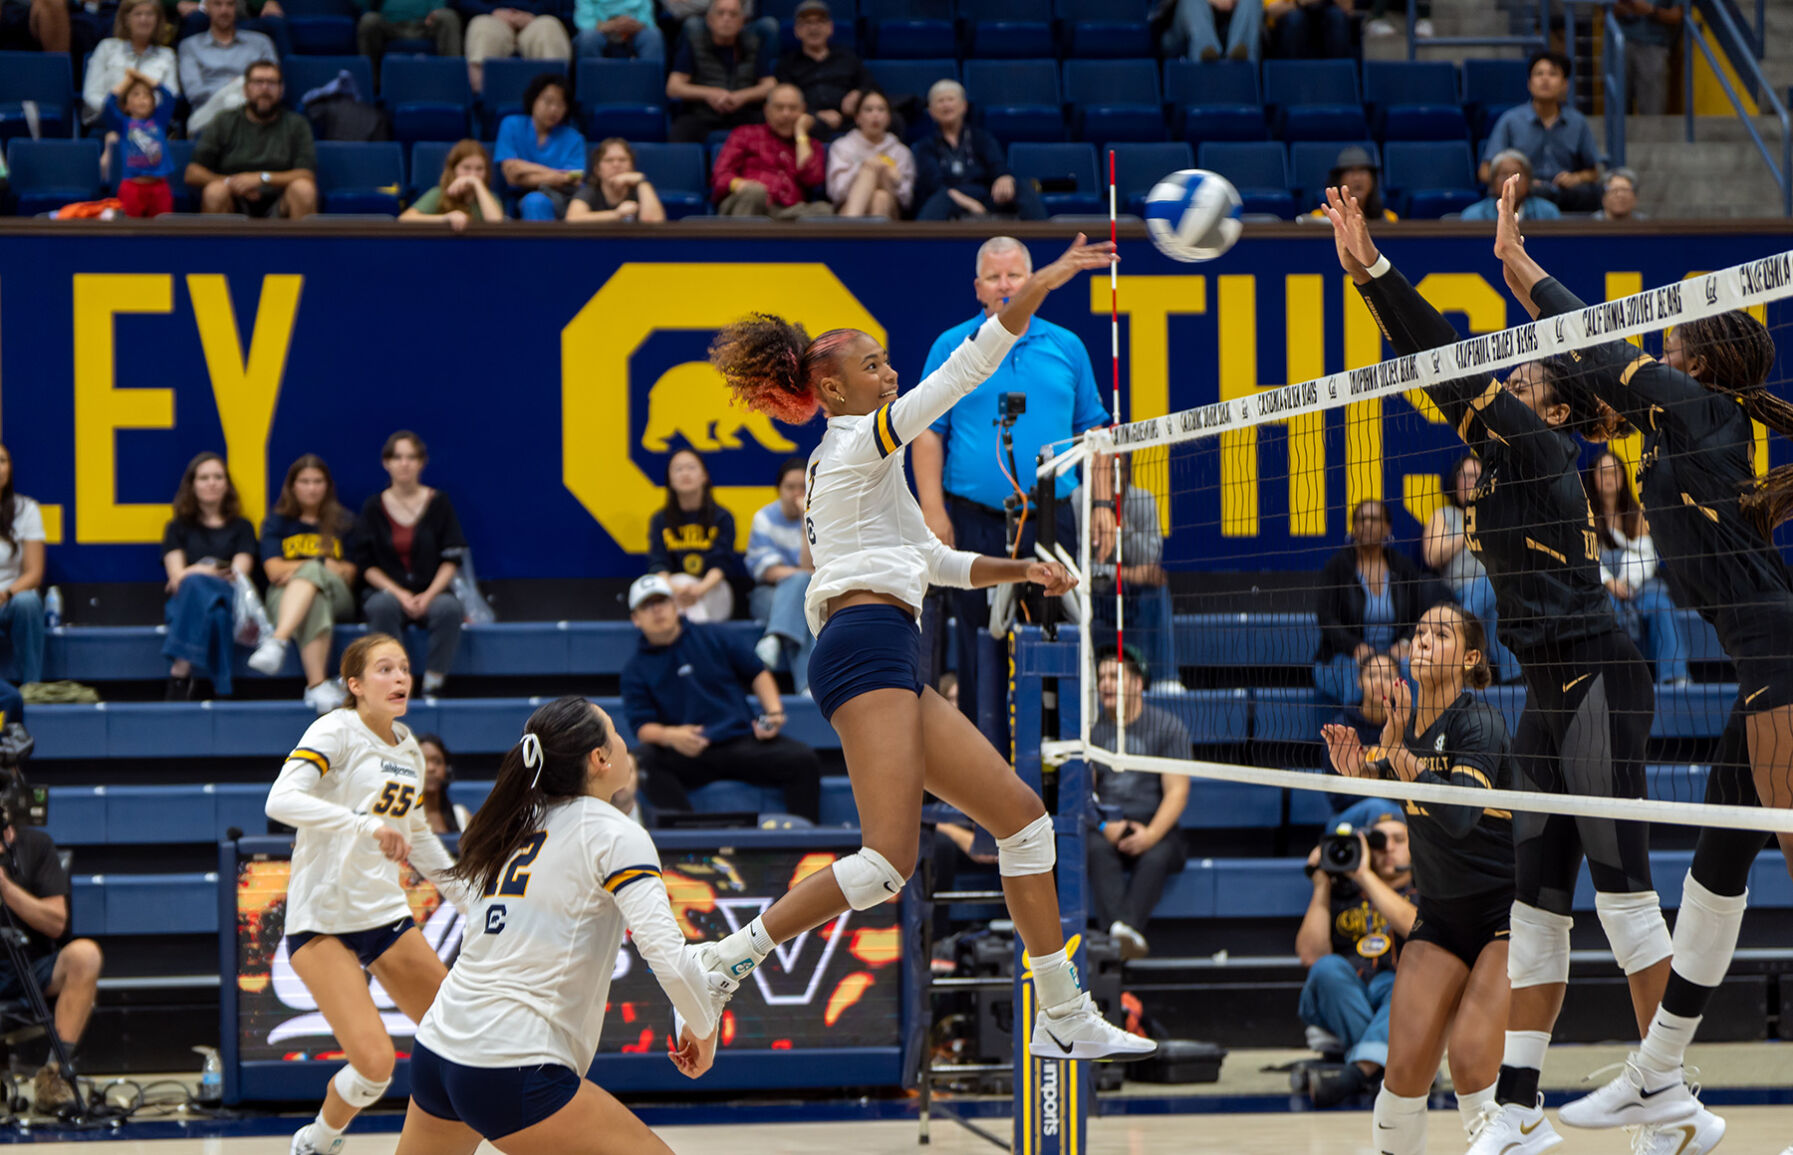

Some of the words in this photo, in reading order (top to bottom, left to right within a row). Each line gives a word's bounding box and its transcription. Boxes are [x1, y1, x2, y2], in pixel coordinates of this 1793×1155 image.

[0, 273, 304, 544] EY
[1090, 273, 1507, 539] THIS
[371, 780, 416, 819] 55
